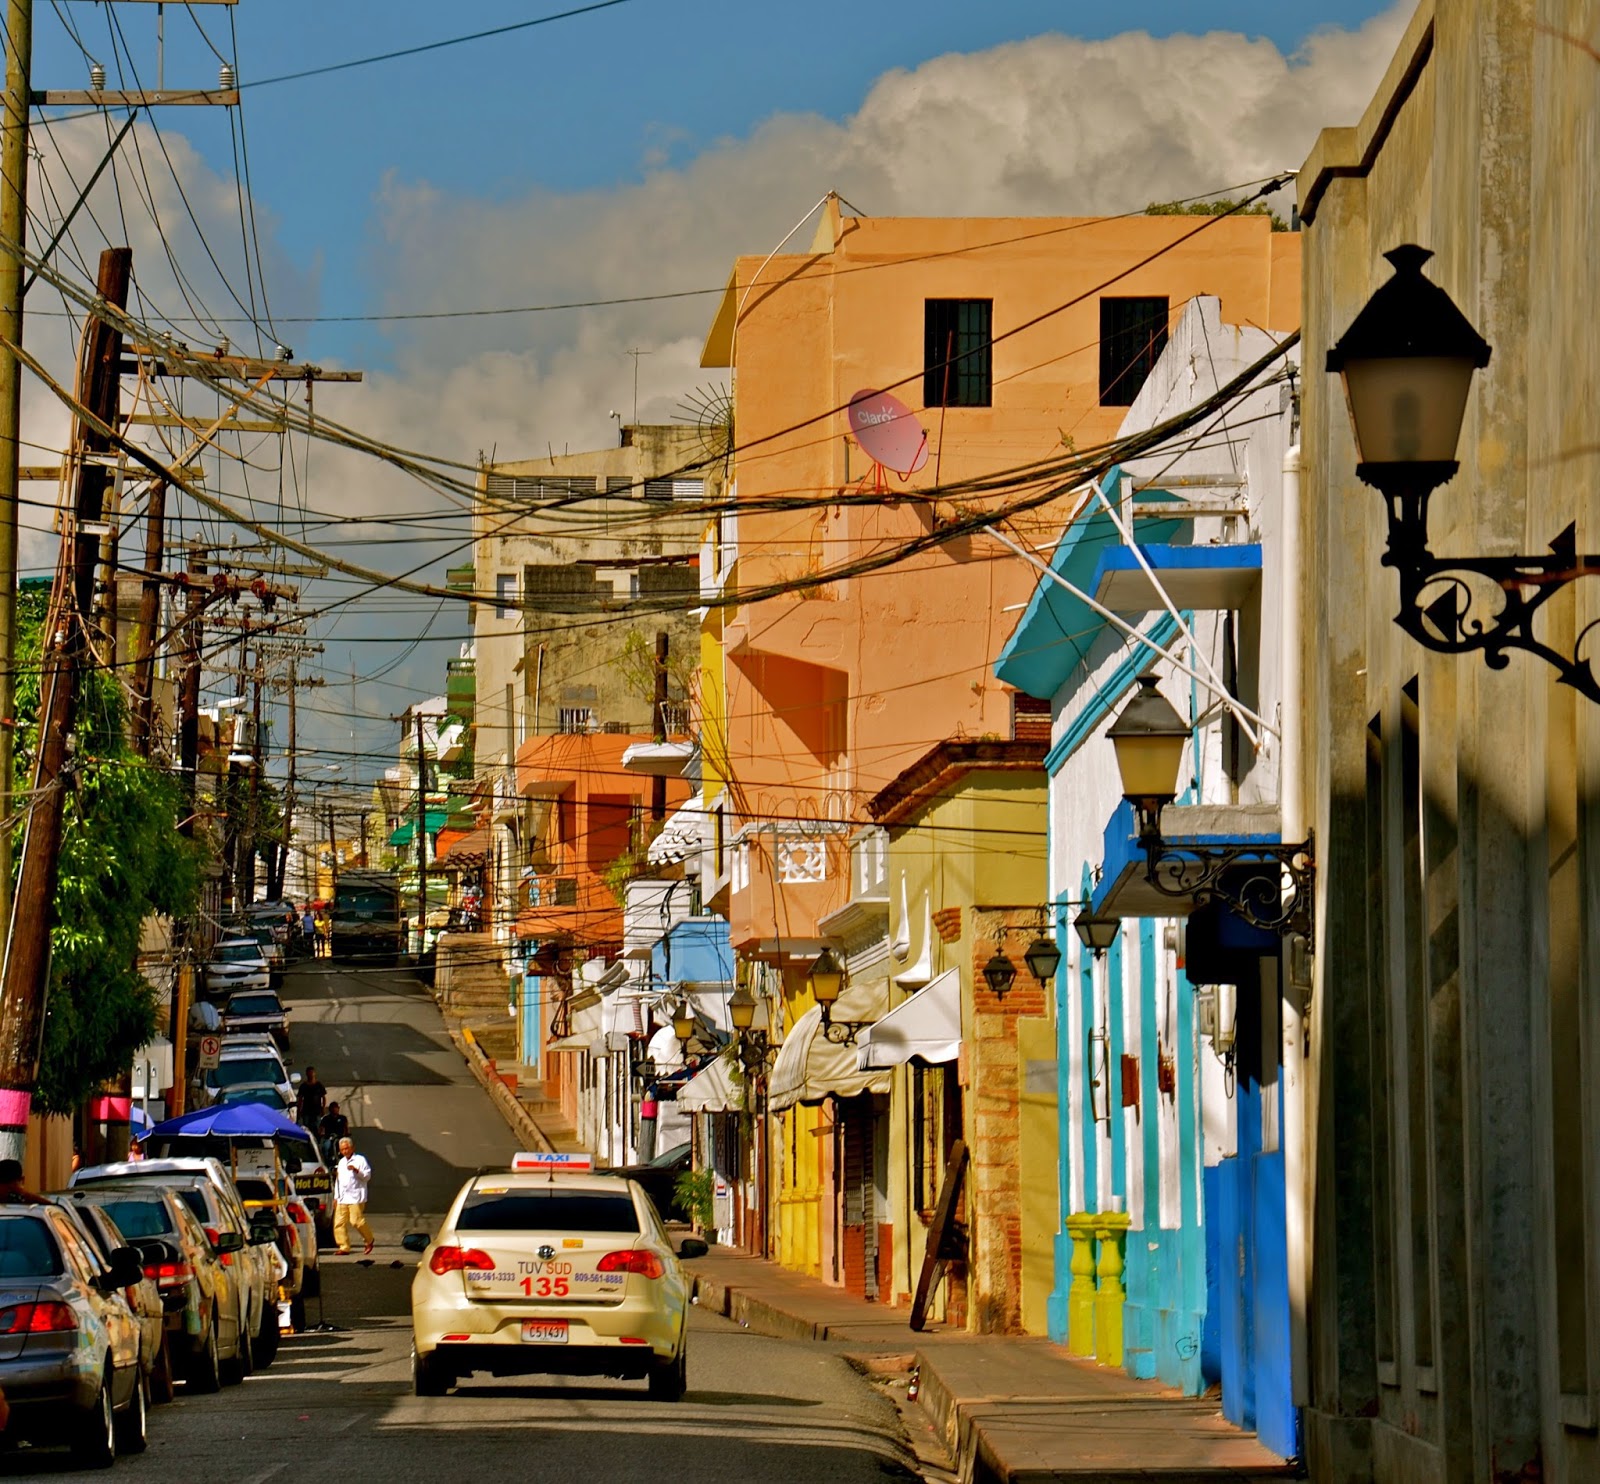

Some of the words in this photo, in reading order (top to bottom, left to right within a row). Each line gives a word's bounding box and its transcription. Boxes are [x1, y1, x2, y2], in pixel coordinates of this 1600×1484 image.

[857, 409, 892, 424] Claro
[535, 1153, 570, 1162] TAXI
[296, 1179, 311, 1188] Hot
[313, 1177, 329, 1189] Dog
[467, 1272, 516, 1281] 809-561-3333
[574, 1272, 624, 1284] 809-561-8888
[520, 1276, 569, 1297] 135
[529, 1326, 566, 1338] C51437
